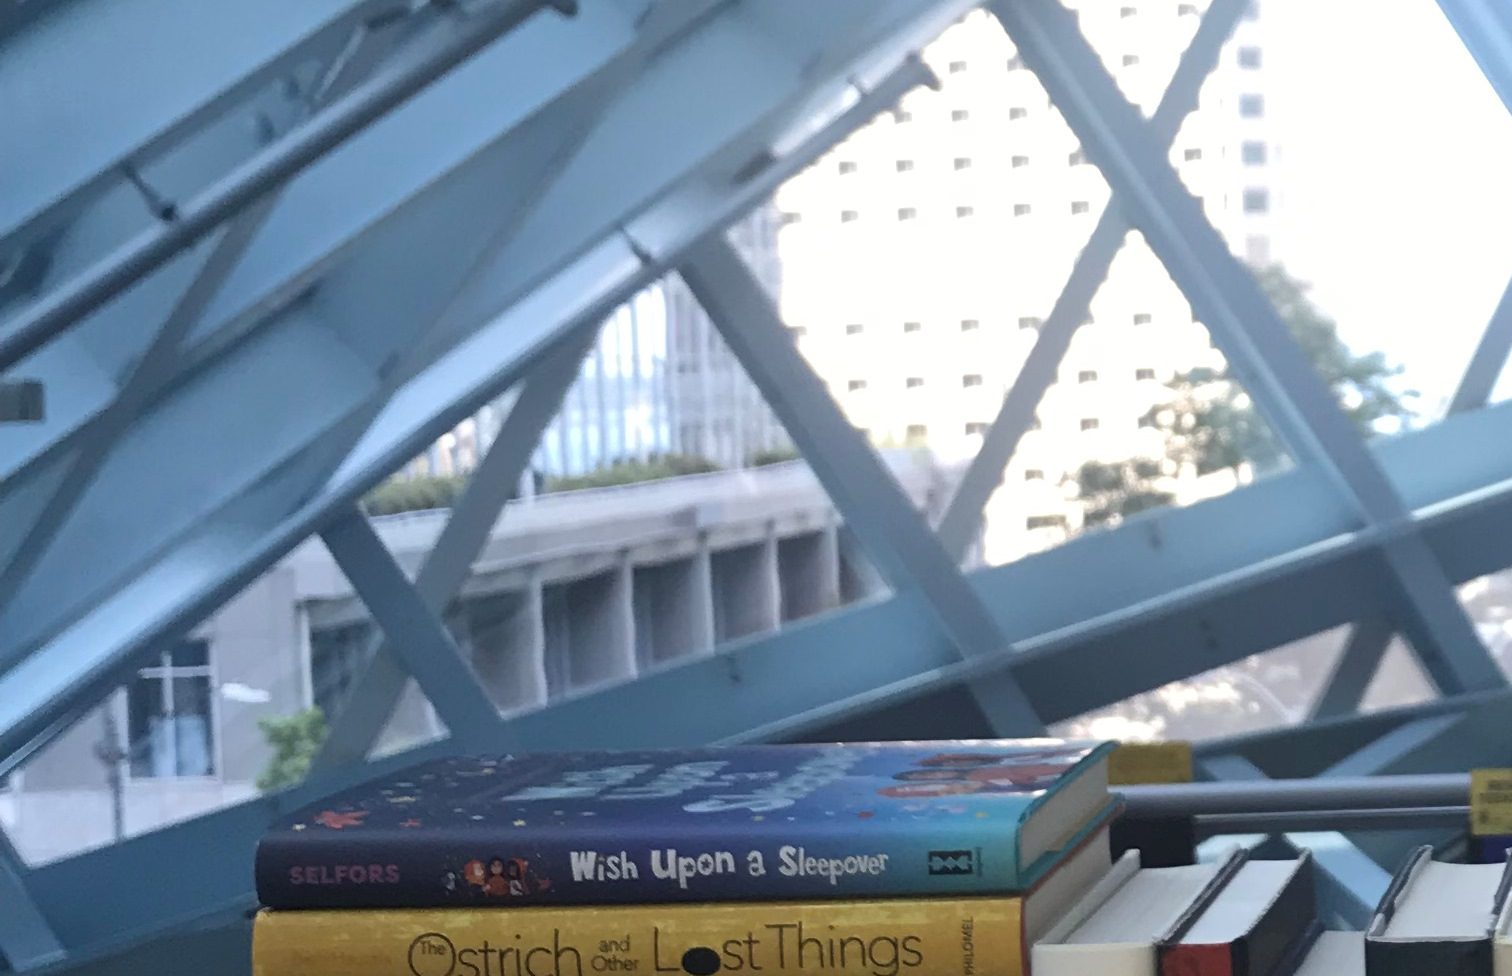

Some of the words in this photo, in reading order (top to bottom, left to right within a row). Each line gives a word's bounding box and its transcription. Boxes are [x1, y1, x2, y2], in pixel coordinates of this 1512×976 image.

[289, 863, 400, 885] SELFORS
[569, 850, 639, 882] Wish
[651, 848, 735, 889] Upon
[778, 845, 889, 885] Sleepover
